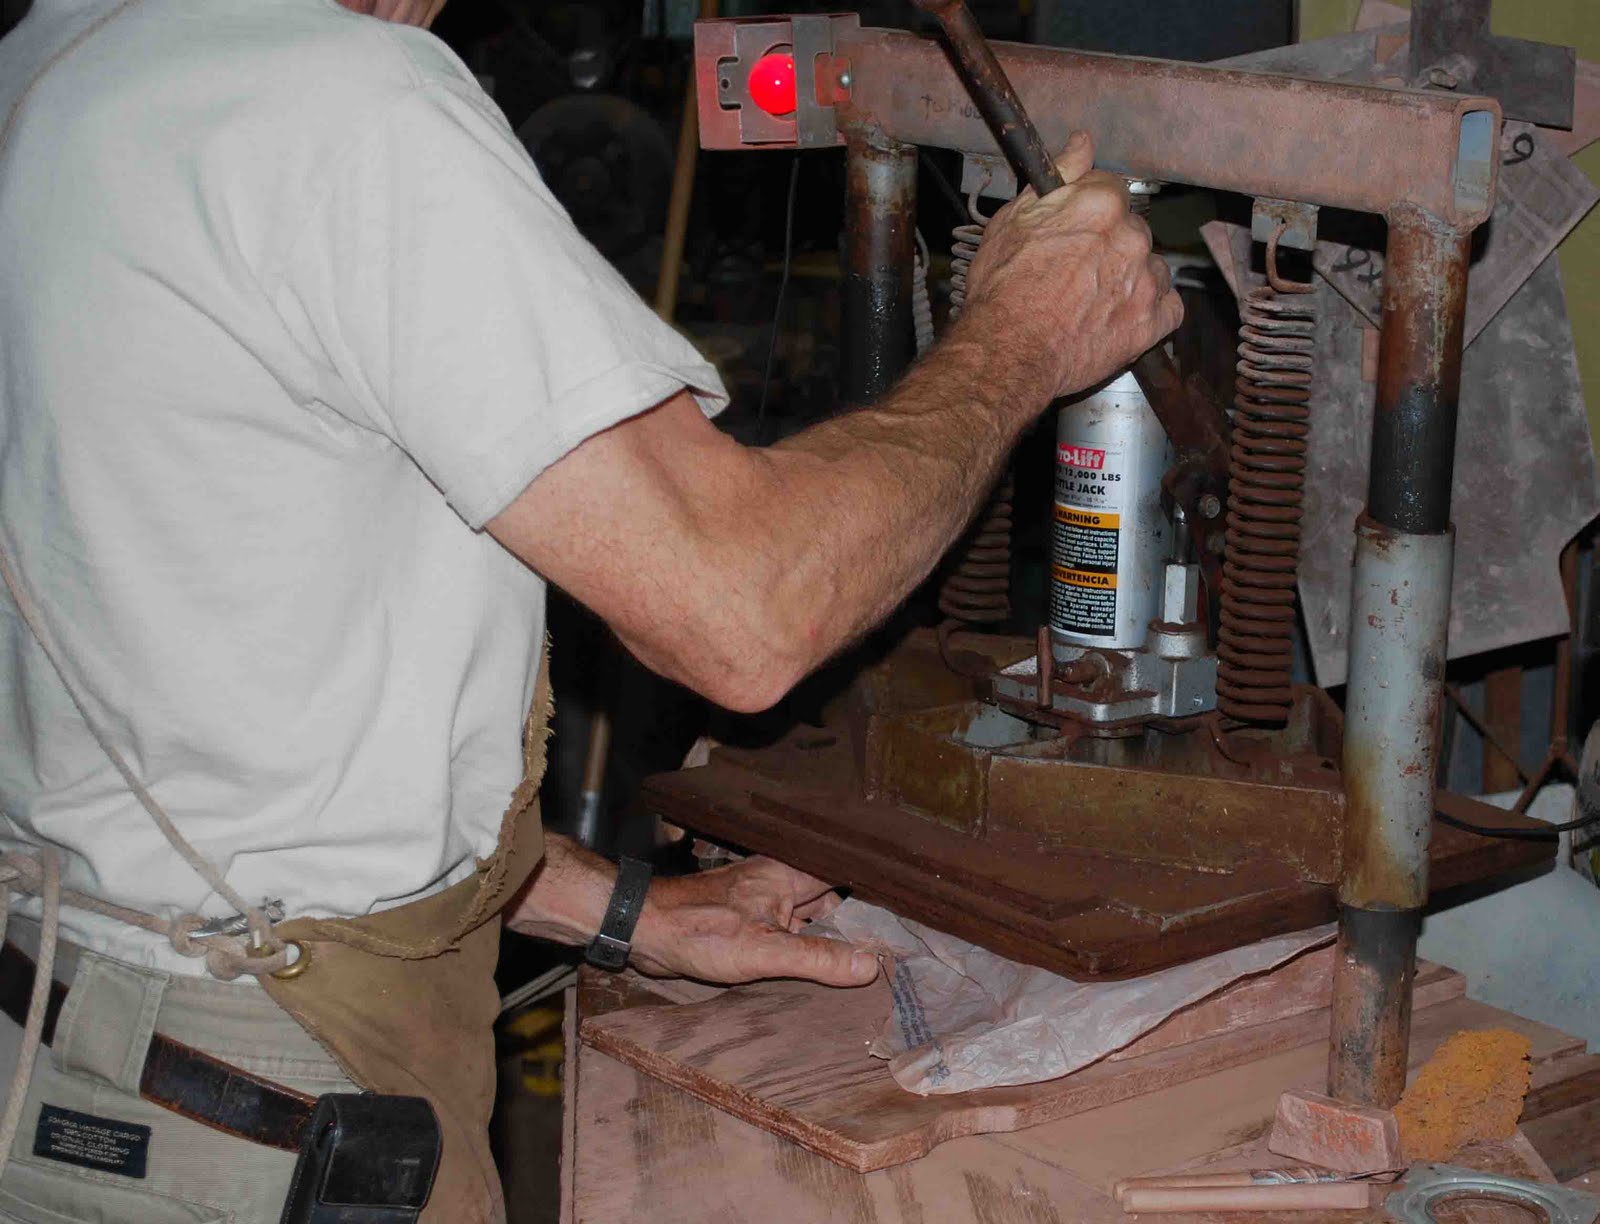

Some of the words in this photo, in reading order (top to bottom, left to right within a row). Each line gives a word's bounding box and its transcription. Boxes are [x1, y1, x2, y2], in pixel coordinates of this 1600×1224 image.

[1057, 449, 1103, 468] ro-Lift
[1101, 473, 1121, 482] LBS
[1077, 484, 1106, 496] JACK
